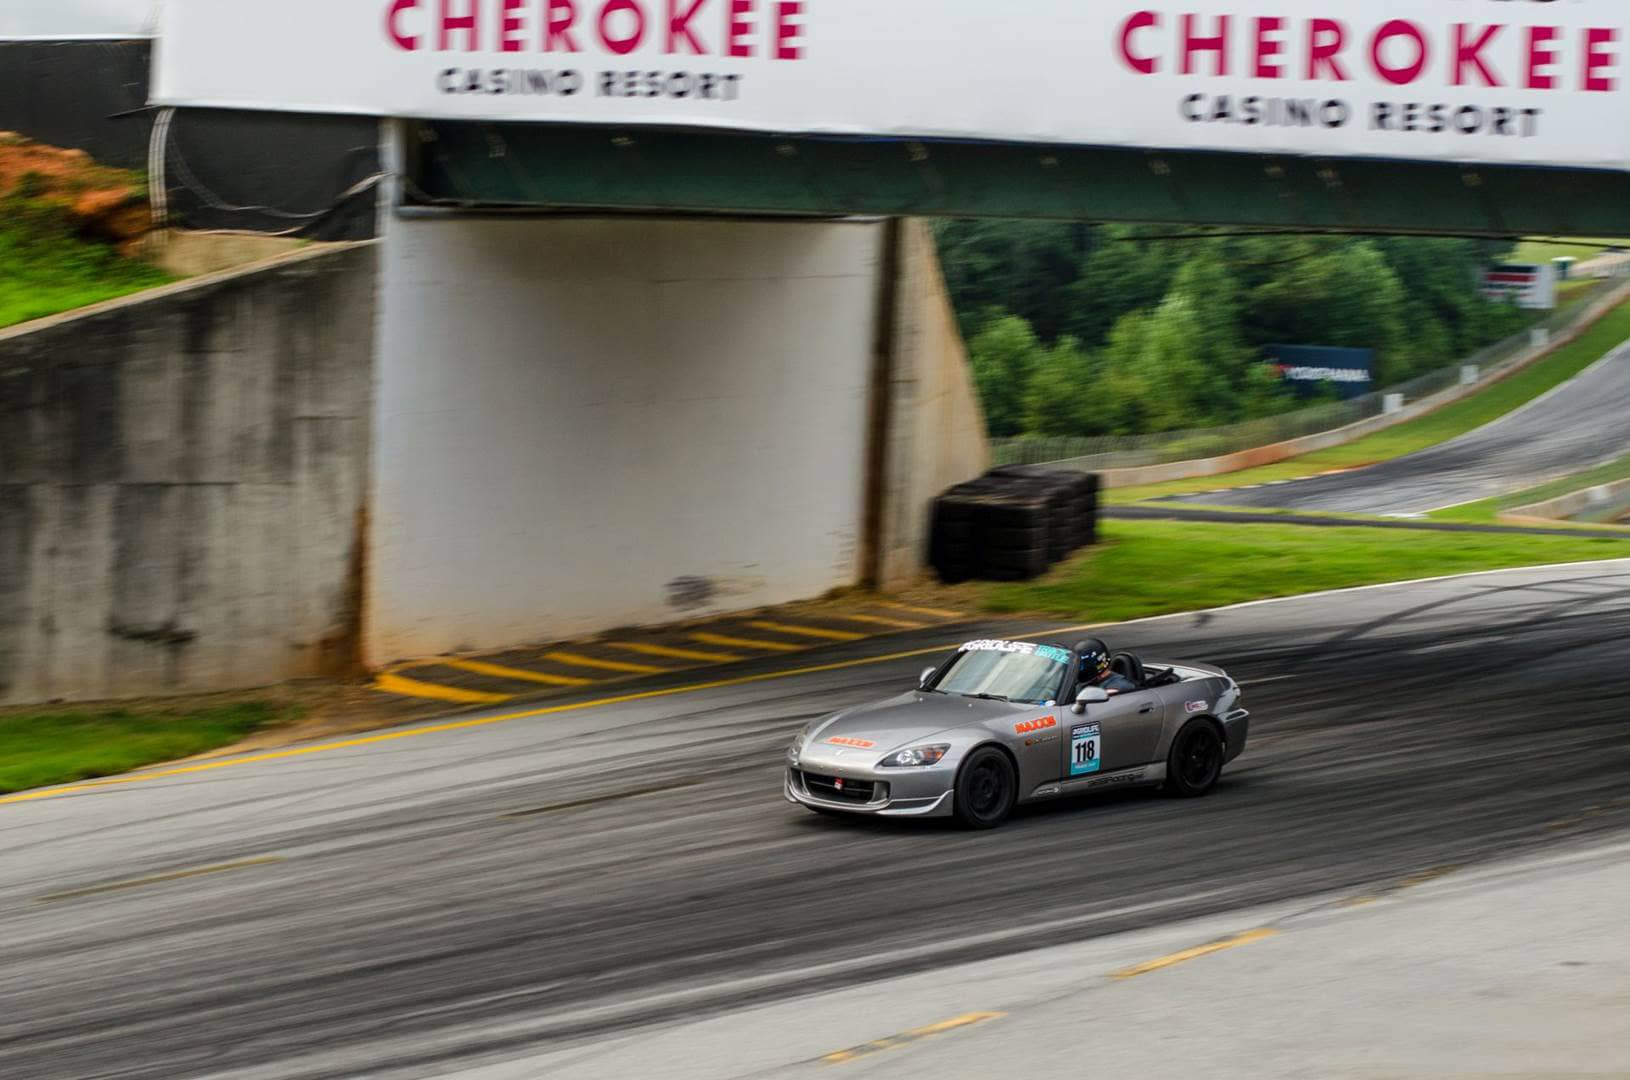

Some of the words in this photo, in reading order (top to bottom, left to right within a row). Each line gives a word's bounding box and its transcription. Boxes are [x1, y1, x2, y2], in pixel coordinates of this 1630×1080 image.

[384, 0, 807, 60] CHEROKEE
[1116, 10, 1618, 92] CHEROKEE
[437, 67, 581, 96] CASINO
[597, 70, 742, 101] RESORT
[1179, 93, 1348, 129] CASINO
[1369, 102, 1542, 137] RESORT
[1075, 740, 1095, 762] 118
